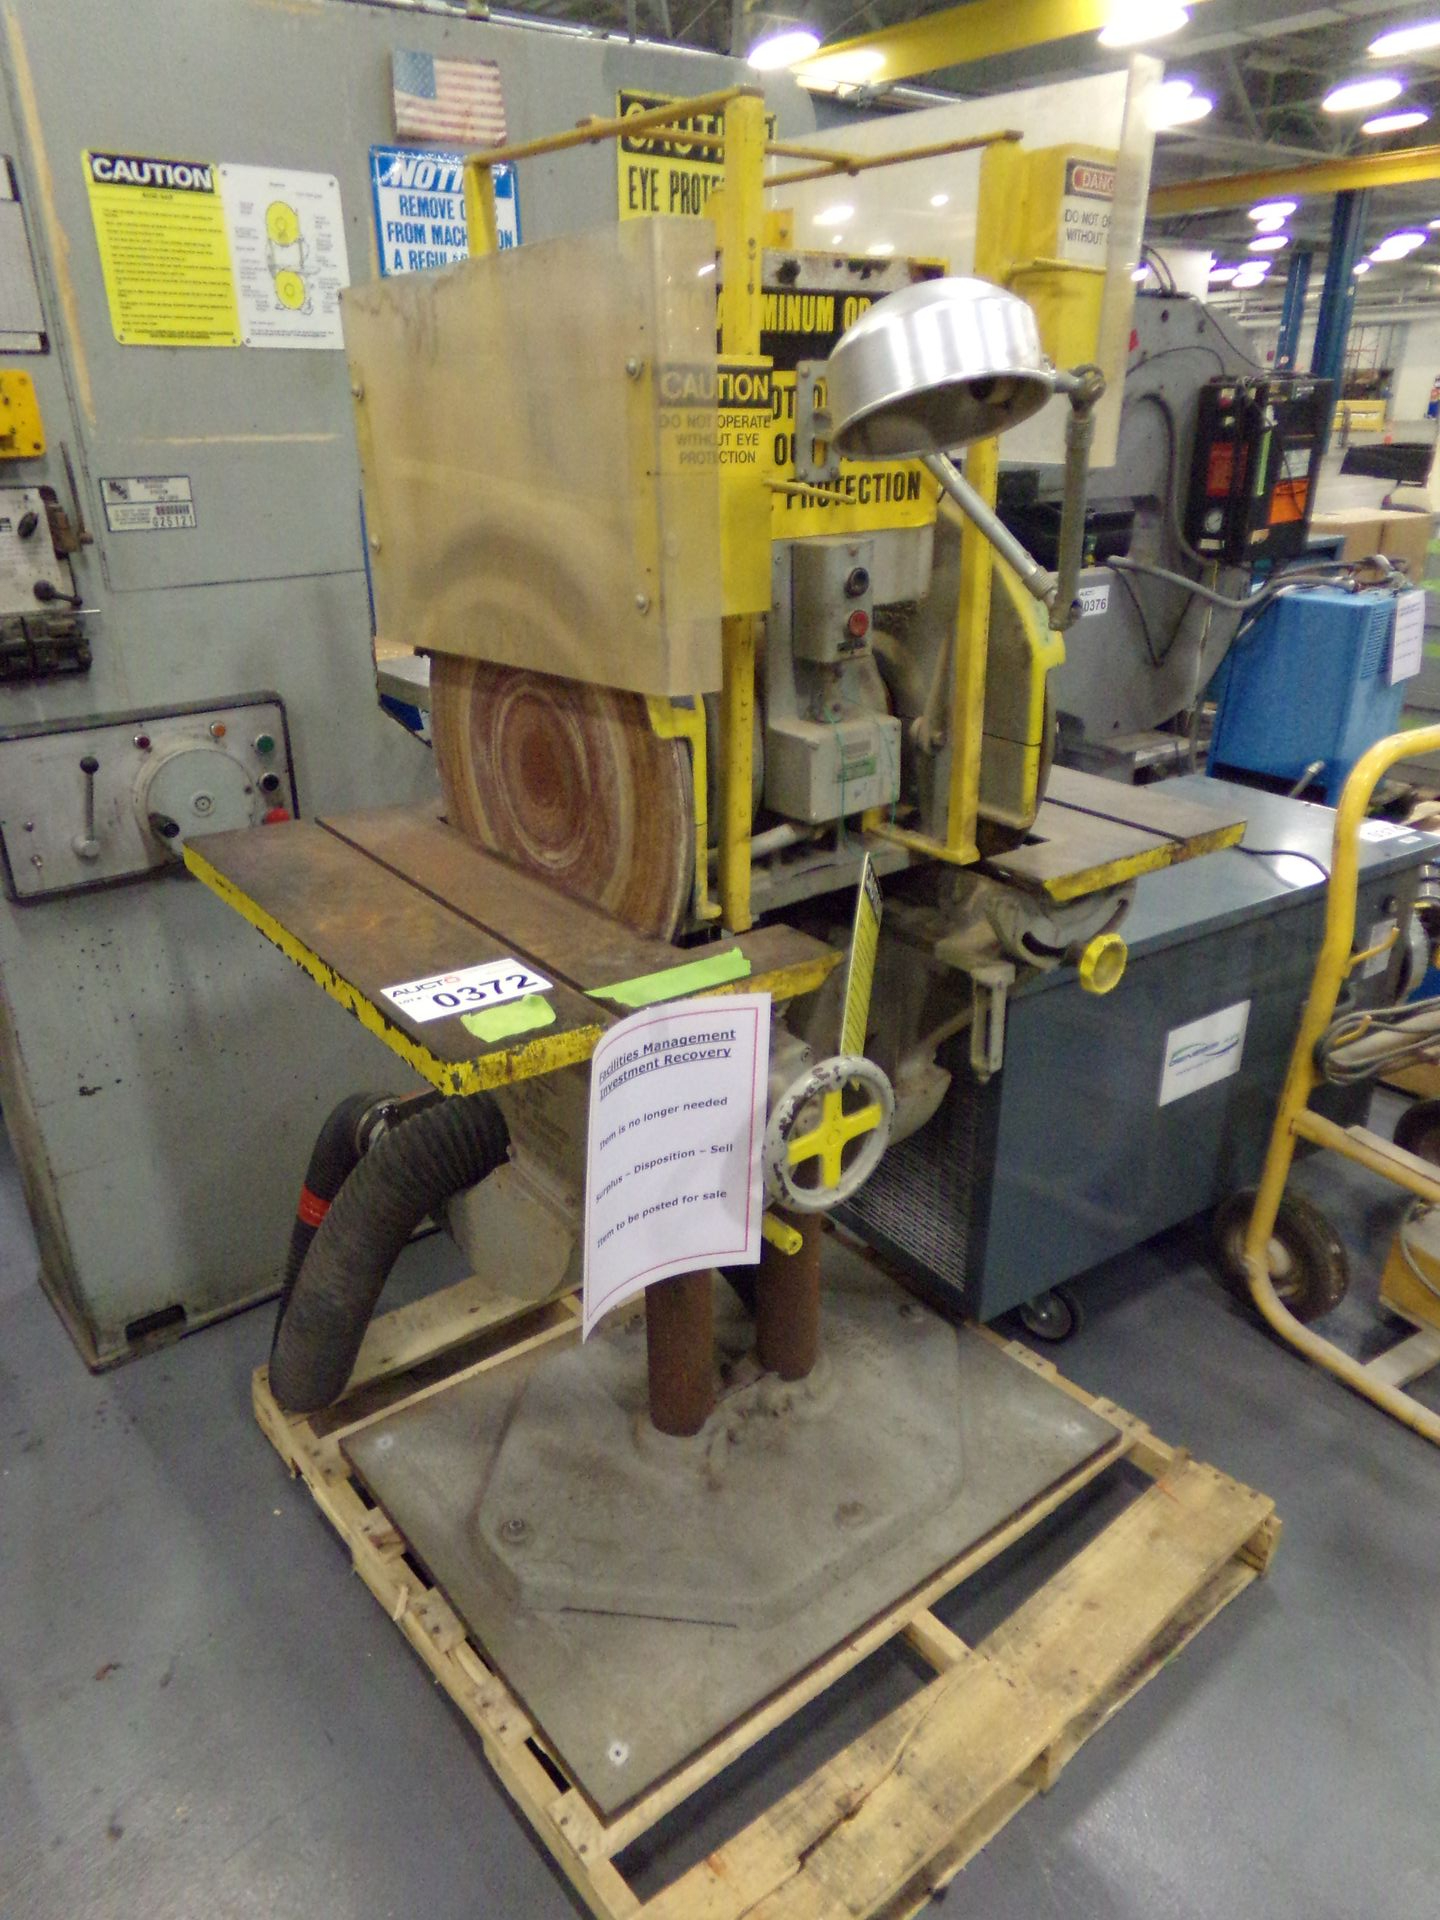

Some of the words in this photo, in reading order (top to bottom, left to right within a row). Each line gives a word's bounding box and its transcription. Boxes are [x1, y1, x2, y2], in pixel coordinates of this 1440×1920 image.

[92, 157, 212, 189] CAUTION
[391, 158, 497, 195] NOTI
[1083, 172, 1115, 193] DANG
[629, 166, 659, 212] EYE
[399, 194, 455, 220] REMOVE
[1065, 209, 1079, 223] DO
[1082, 211, 1099, 226] NOT
[387, 221, 426, 245] FROM
[1066, 228, 1104, 245] WITHOUT
[394, 248, 404, 270] A
[661, 371, 770, 401] CAUTION
[659, 415, 681, 428] DO
[687, 415, 714, 428] NOT
[718, 415, 772, 428] OPERATE
[677, 433, 732, 446] WITHOUT
[737, 433, 759, 446] EYE
[679, 450, 756, 465] PROTECTION
[432, 974, 538, 1007] 0372
[599, 1049, 639, 1081] Facilities
[643, 1029, 737, 1055] Management
[600, 1059, 660, 1099] Investment
[664, 1048, 732, 1065] Recovery
[600, 1131, 617, 1150] Item
[619, 1124, 627, 1135] is
[629, 1118, 641, 1129] no
[644, 1105, 680, 1121] longer
[683, 1097, 728, 1111] needed
[634, 1150, 695, 1174] Disposition
[710, 1144, 733, 1154] Sell
[597, 1229, 614, 1248] Item
[616, 1221, 626, 1231] to
[628, 1214, 639, 1224] be
[642, 1198, 678, 1219] posted
[682, 1194, 700, 1204] for
[703, 1190, 728, 1200] sale
